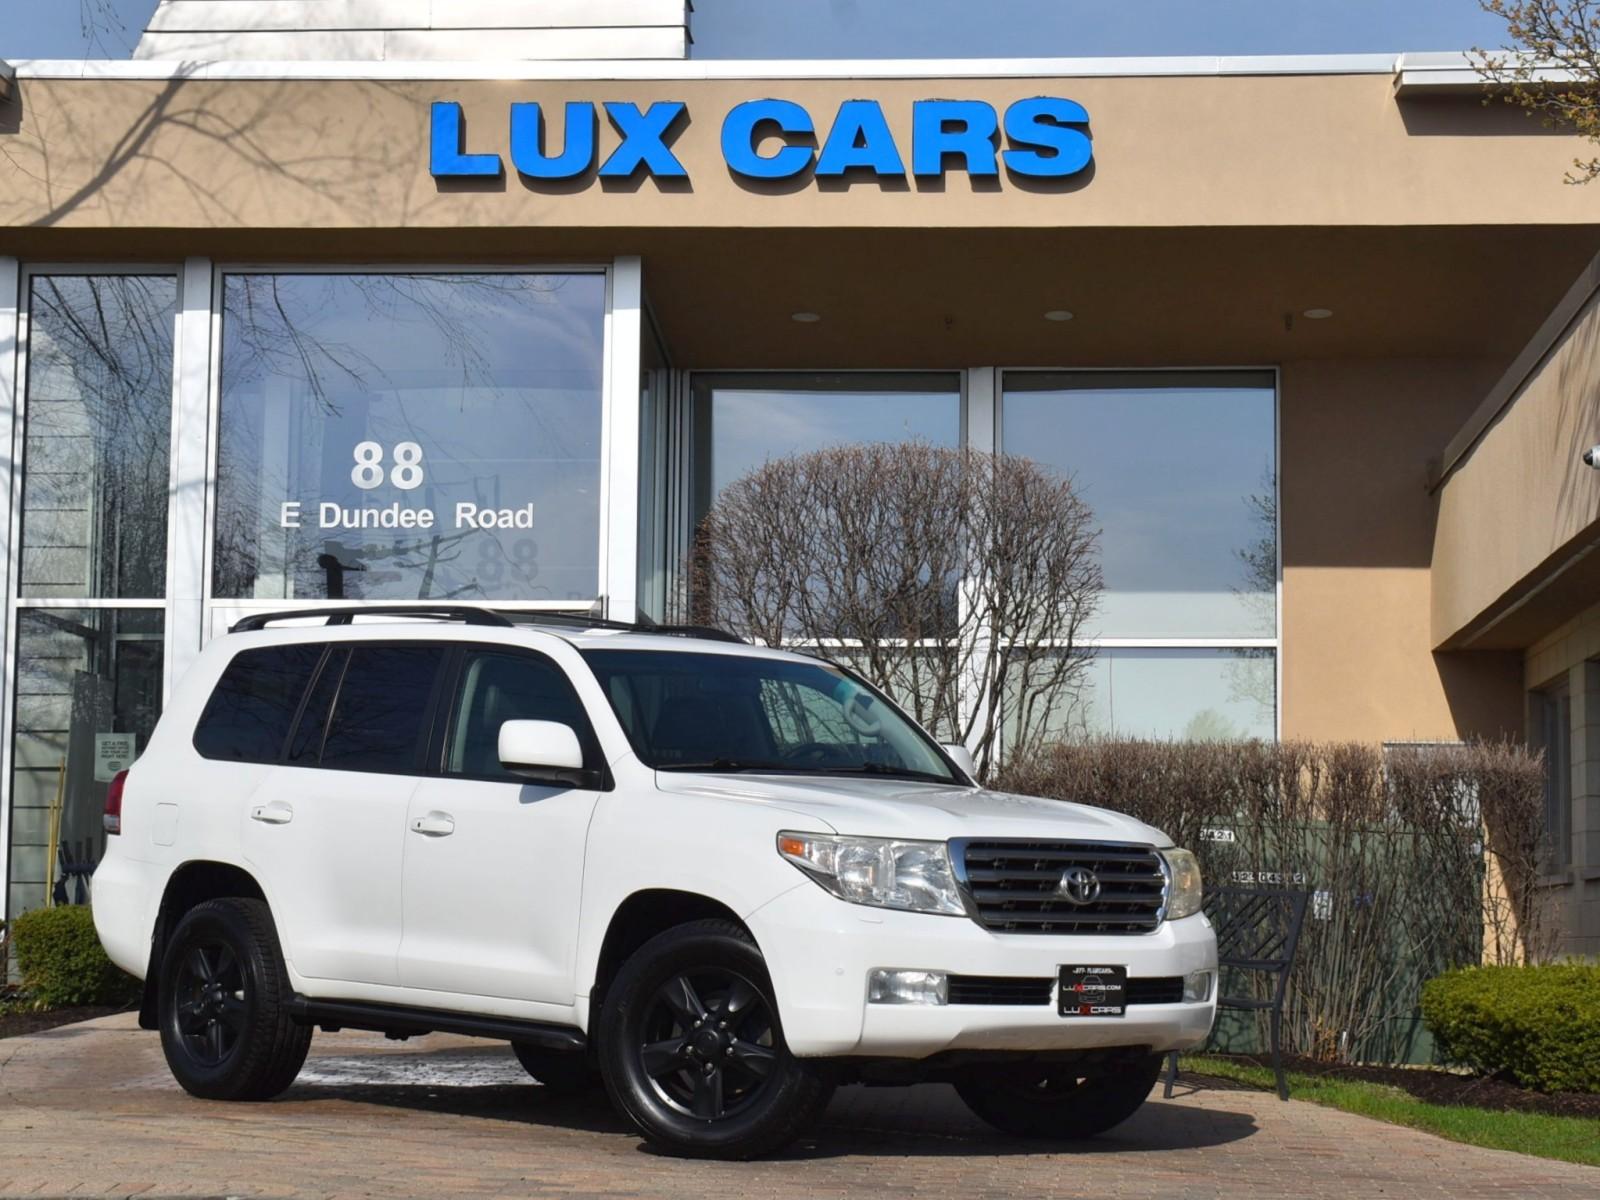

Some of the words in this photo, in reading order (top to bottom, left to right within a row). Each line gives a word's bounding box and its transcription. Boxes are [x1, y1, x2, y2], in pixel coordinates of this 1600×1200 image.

[430, 101, 688, 178] LUX
[720, 97, 1093, 178] CARS
[351, 441, 424, 489] 88
[280, 502, 301, 528] E
[319, 502, 434, 529] Dundee
[455, 502, 534, 529] Road
